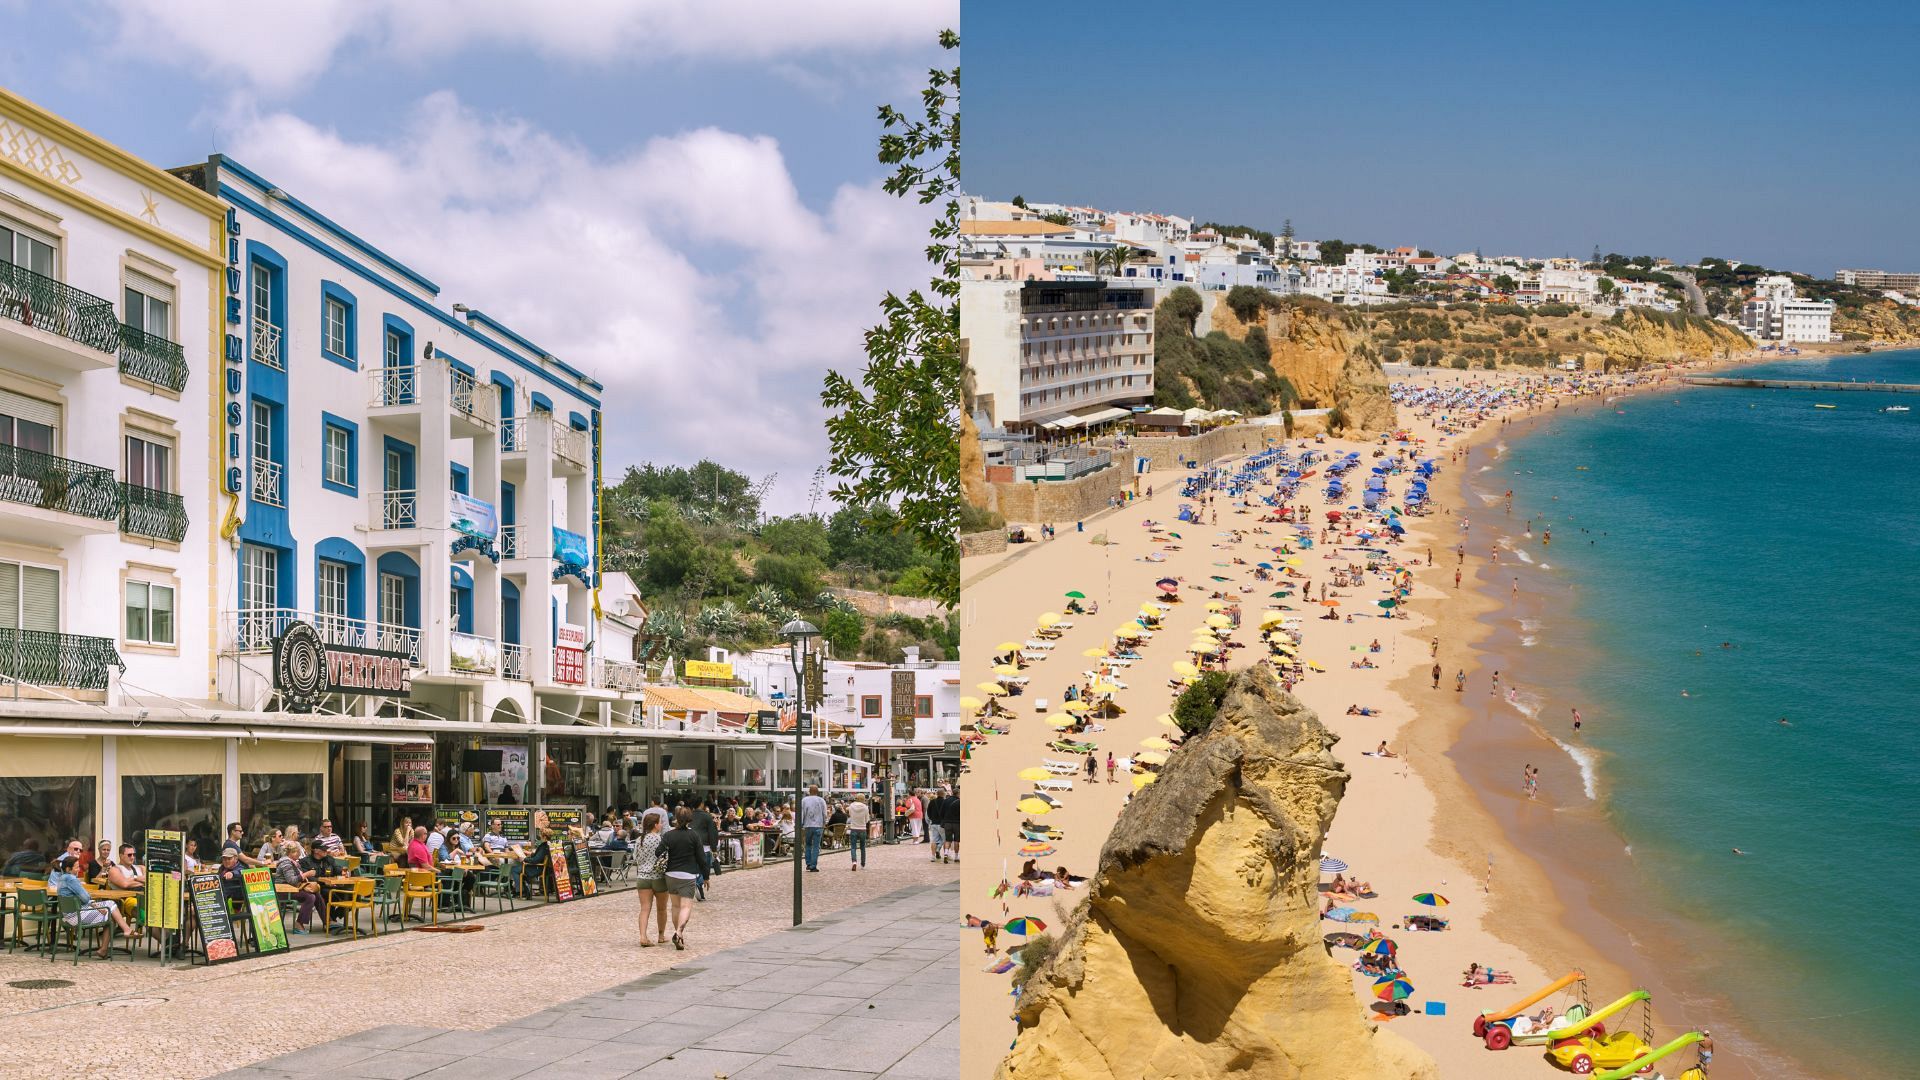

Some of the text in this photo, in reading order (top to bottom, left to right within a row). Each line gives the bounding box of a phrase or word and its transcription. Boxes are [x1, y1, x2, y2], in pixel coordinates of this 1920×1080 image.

[226, 206, 243, 492] LIVE MUSIC
[325, 650, 401, 690] VERTIGO
[806, 655, 815, 690] BRAVO
[895, 683, 912, 694] STEAK
[394, 761, 431, 770] LIVE MUSIC
[244, 870, 271, 884] MOJITO
[194, 880, 220, 892] PIZZAS
